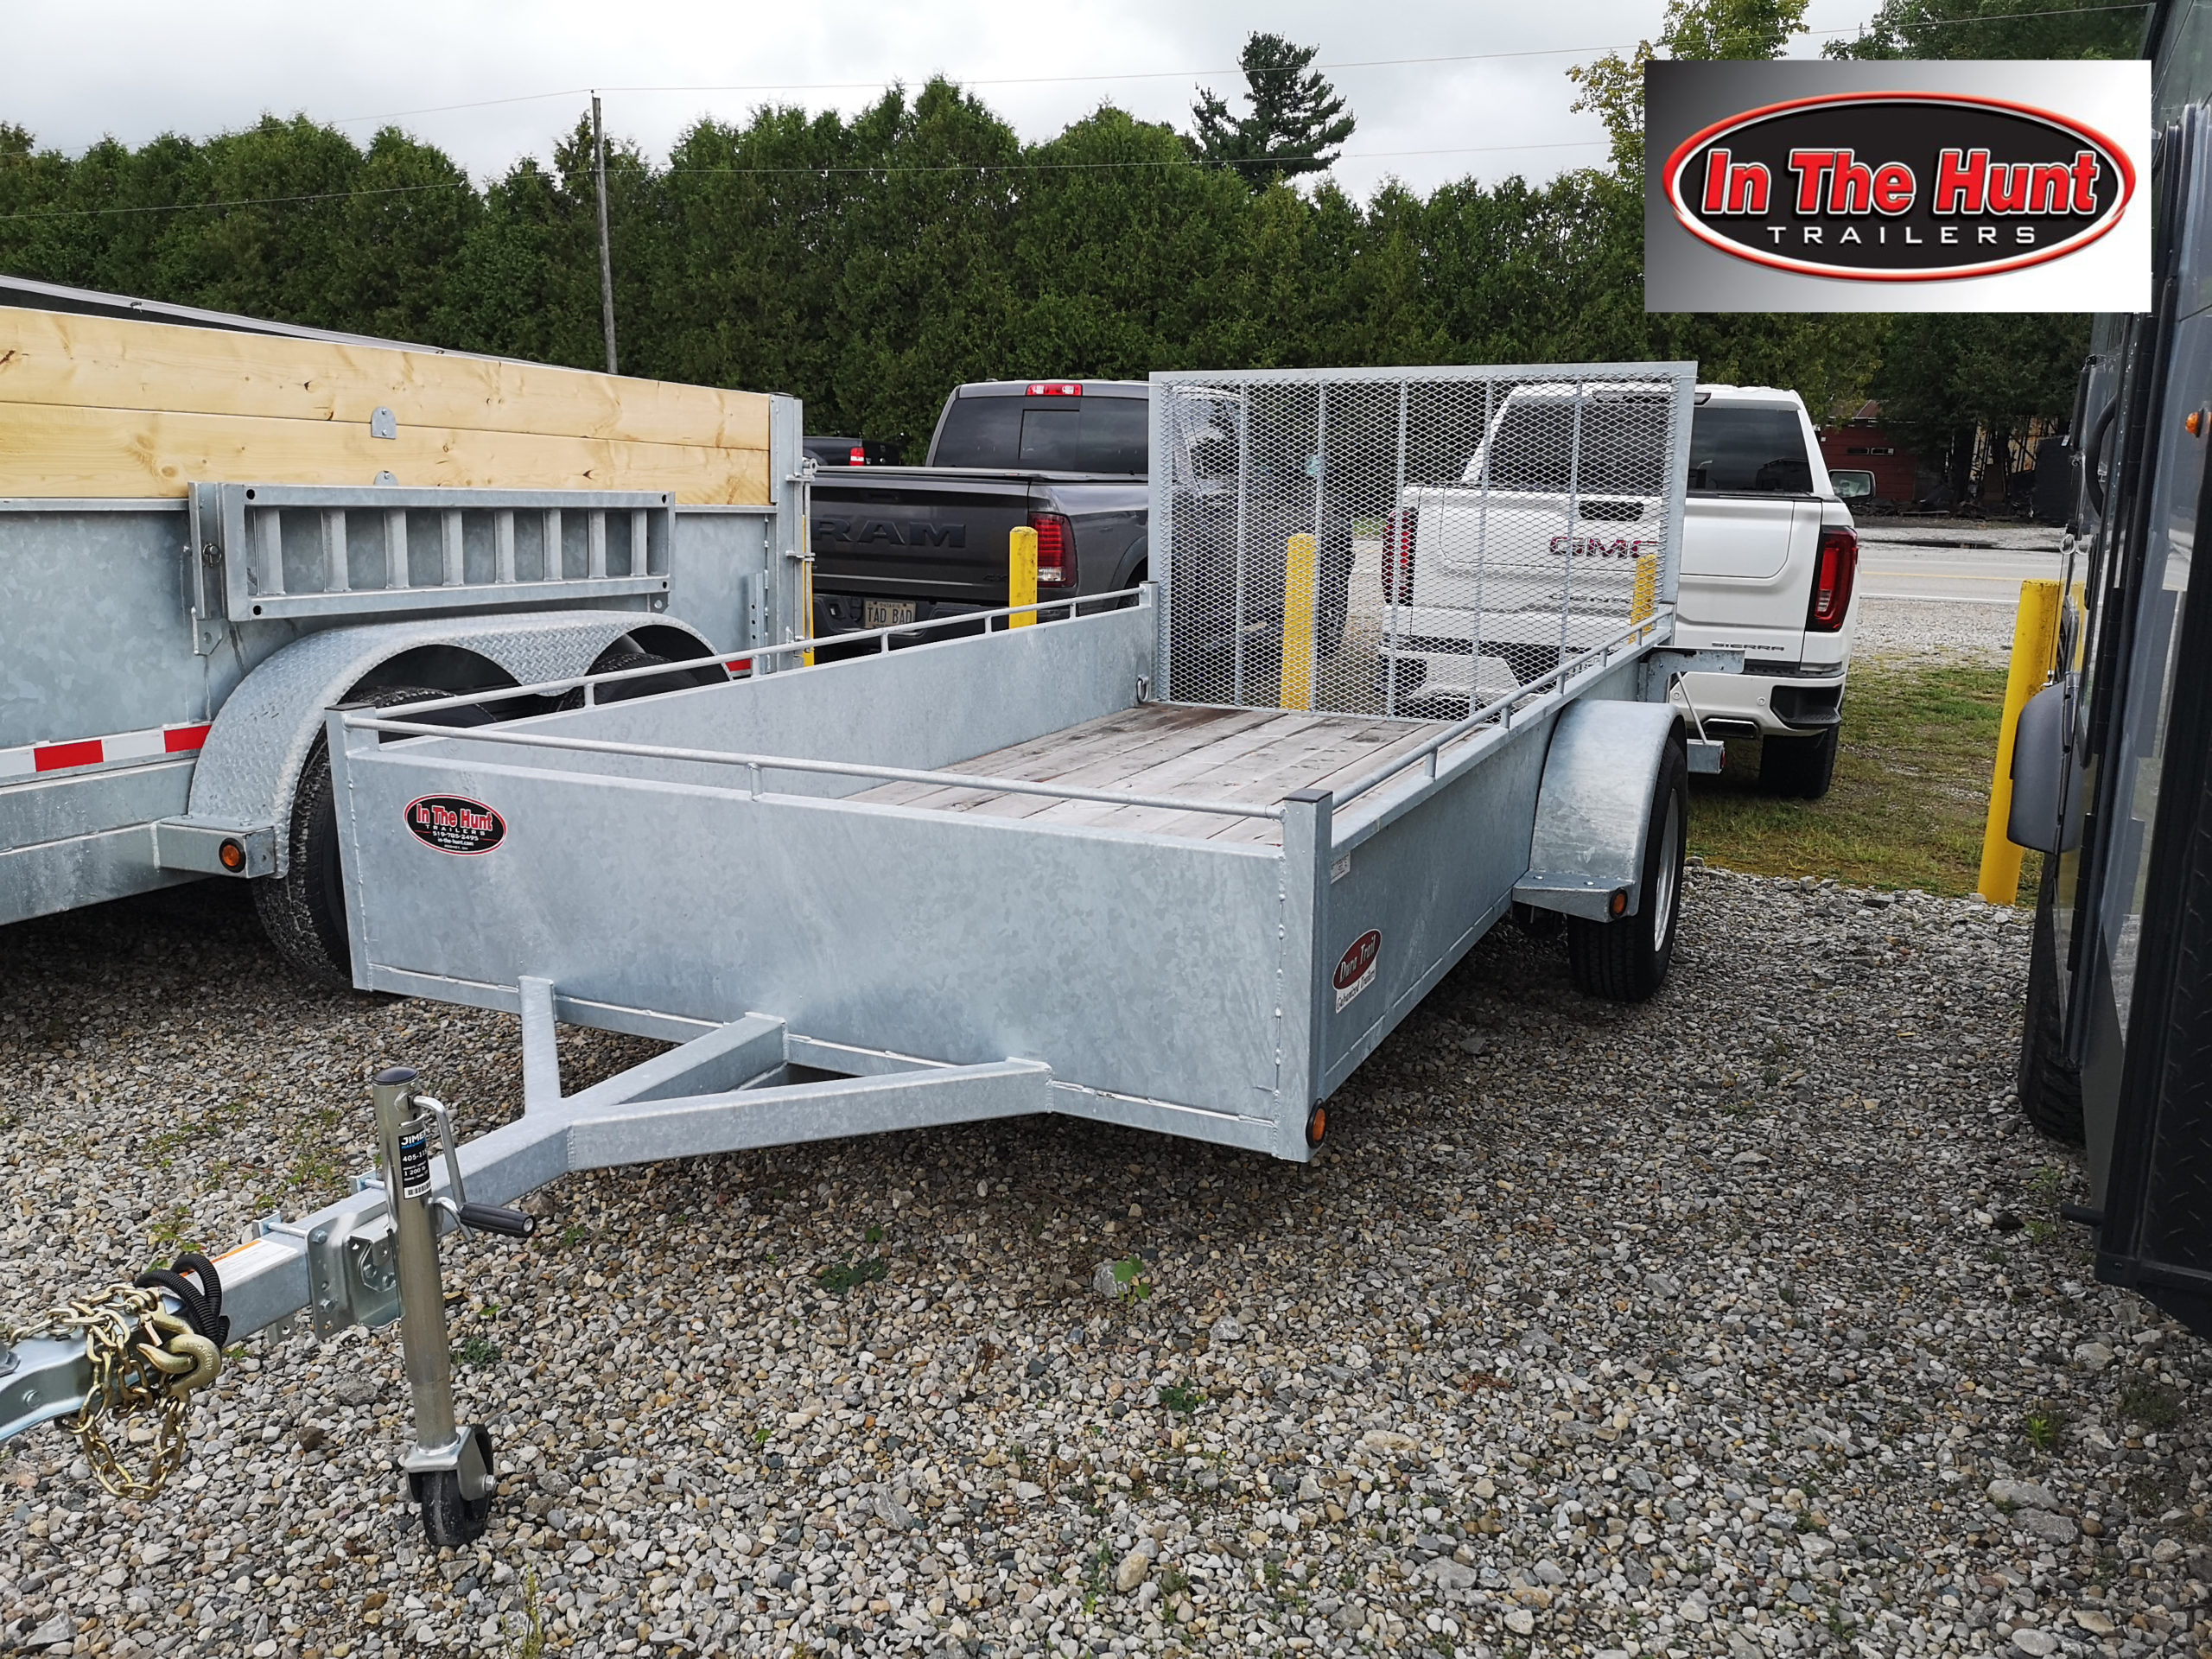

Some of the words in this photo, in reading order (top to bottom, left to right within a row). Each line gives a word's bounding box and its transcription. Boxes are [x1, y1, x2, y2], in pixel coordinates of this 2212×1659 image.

[810, 518, 967, 549] RAM
[1549, 536, 1659, 558] GMC
[868, 607, 887, 623] TAD
[892, 608, 912, 625] BAD
[1712, 642, 1784, 652] SIERRA
[416, 804, 430, 823] In
[432, 805, 457, 827] The
[461, 809, 493, 831] Hunt
[425, 823, 486, 836] TRAILERS
